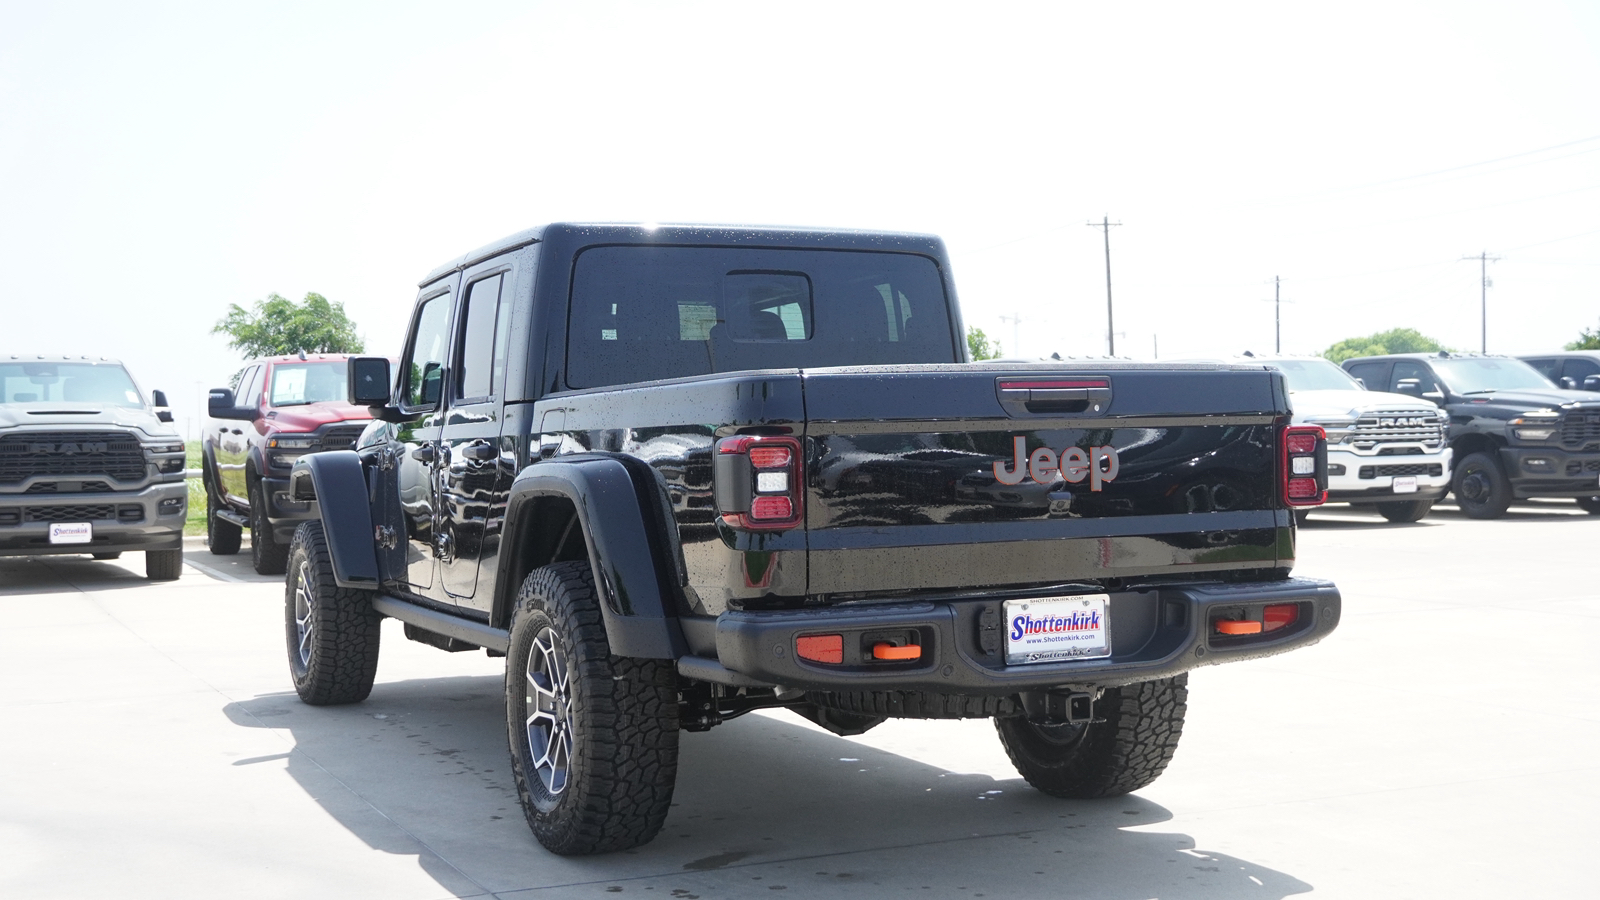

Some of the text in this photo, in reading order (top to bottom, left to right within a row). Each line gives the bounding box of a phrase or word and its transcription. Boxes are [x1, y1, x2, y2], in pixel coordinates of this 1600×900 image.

[1380, 417, 1422, 426] RAM
[30, 443, 107, 453] RAM
[992, 435, 1120, 492] Jeep
[1011, 609, 1101, 641] Shottenkirk
[1026, 633, 1095, 644] www.Shottenkirk.com
